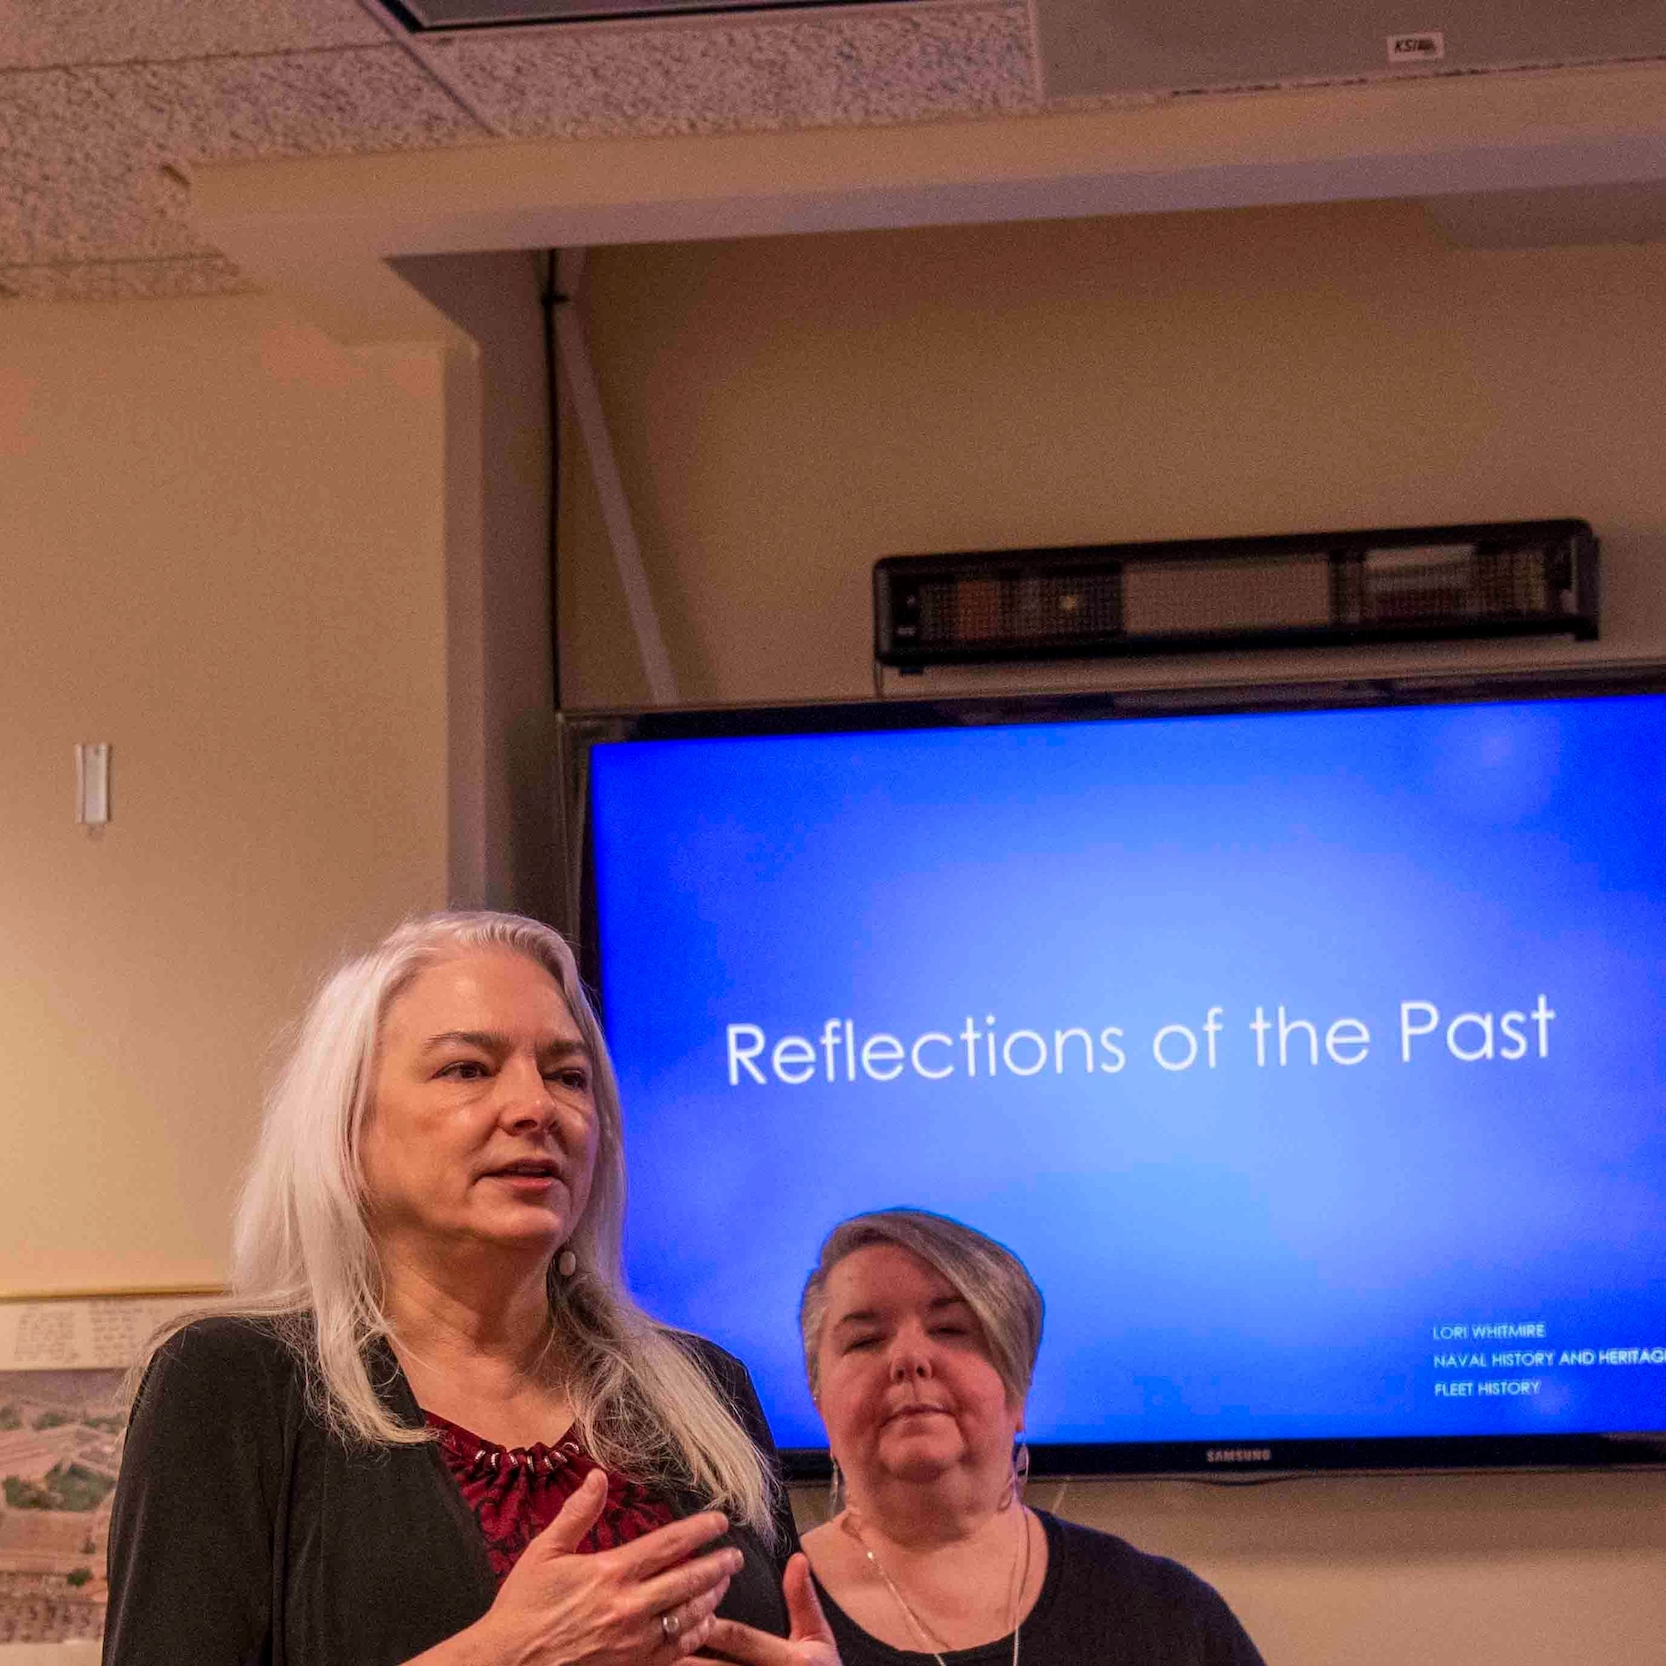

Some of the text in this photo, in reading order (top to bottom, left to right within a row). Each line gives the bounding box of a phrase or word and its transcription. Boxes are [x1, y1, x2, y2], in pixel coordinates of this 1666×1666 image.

[727, 994, 1555, 1086] Reflections of the Past
[1433, 1323, 1546, 1340] LORI WHITMIRE
[1434, 1353, 1487, 1368] NAVAL
[1491, 1351, 1555, 1367] HISTORY
[1558, 1349, 1596, 1366] AND
[1434, 1380, 1541, 1397] FLEET HISTORY
[1206, 1449, 1271, 1463] SAMSUNG
